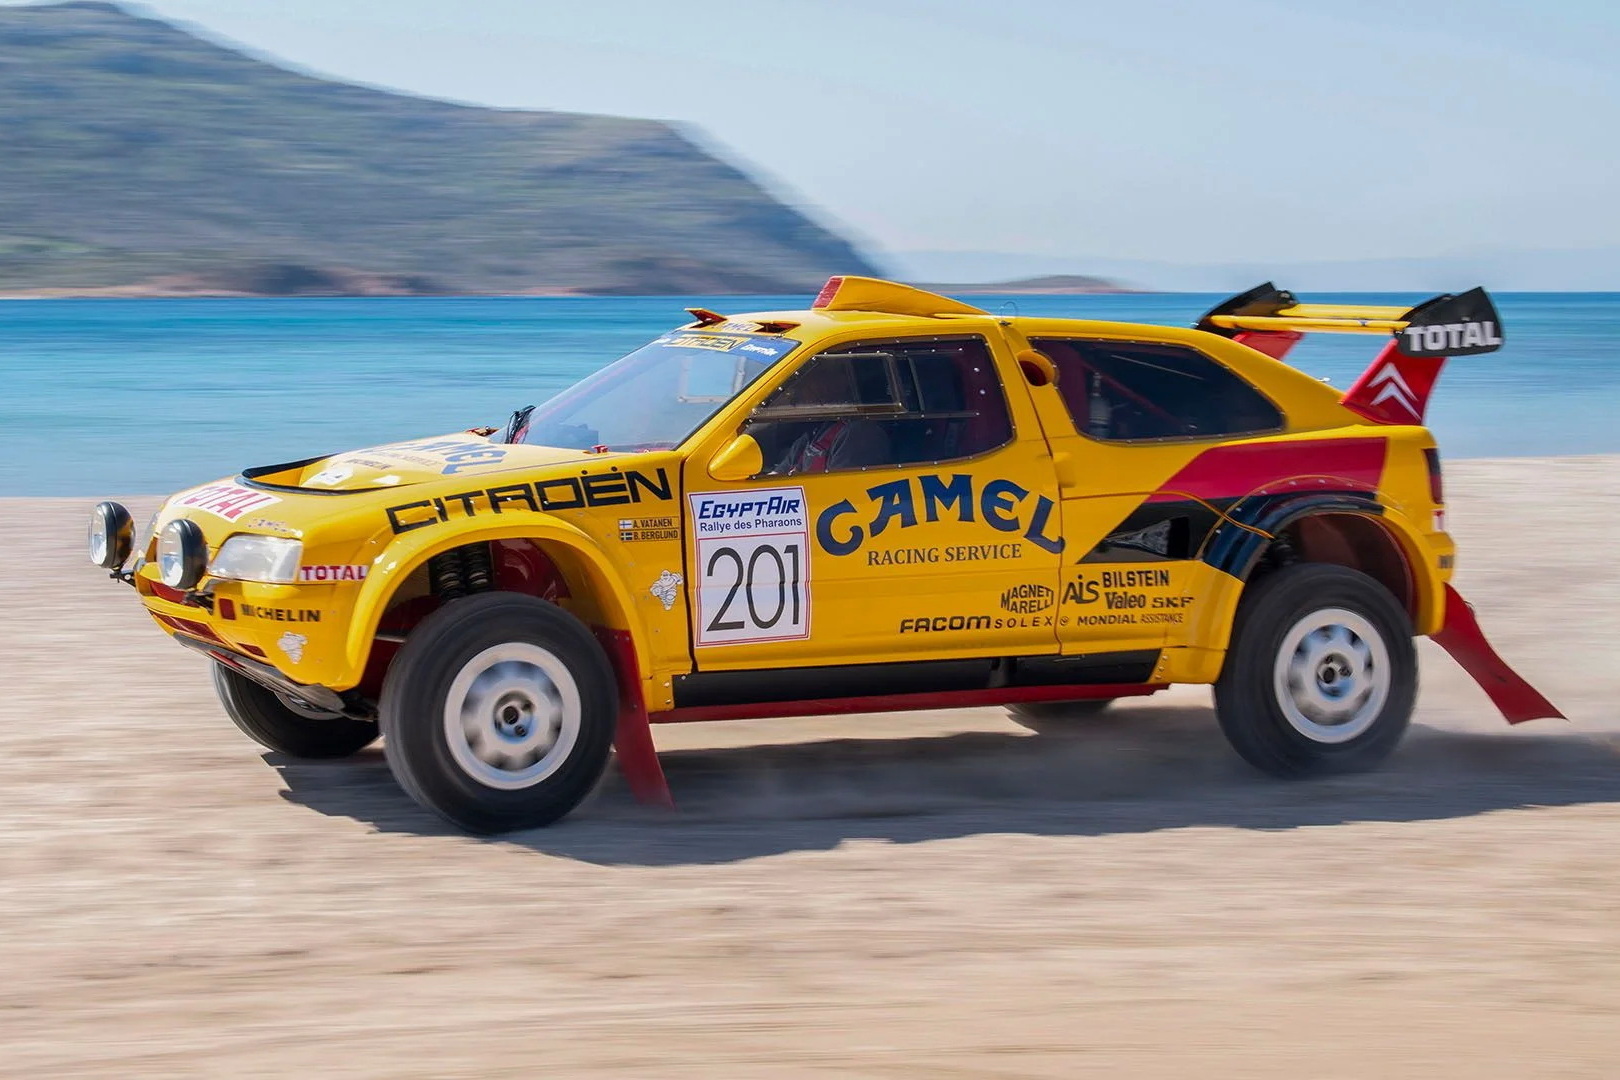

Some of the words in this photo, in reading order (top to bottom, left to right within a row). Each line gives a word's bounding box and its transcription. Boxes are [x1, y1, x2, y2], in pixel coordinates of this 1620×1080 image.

[1405, 321, 1501, 351] TOTAL
[173, 486, 272, 519] TOTAL
[816, 473, 1065, 556] CAMEL
[633, 520, 640, 528] A.
[641, 519, 673, 528] VATANEN
[700, 522, 731, 533] Rallye
[734, 520, 752, 530] des
[754, 518, 802, 528] Pharaons
[634, 532, 640, 540] B.
[641, 530, 678, 540] BERGLUND
[867, 548, 939, 566] RACING
[945, 543, 1022, 561] SERVICE
[302, 566, 366, 580] TOTAL
[1103, 570, 1169, 588] BILSTEIN
[707, 544, 799, 631] 201
[1105, 592, 1146, 609] Valeo
[1152, 597, 1194, 609] SKF
[241, 604, 321, 622] MICHELIN
[1077, 614, 1137, 626] MONDIAL
[994, 616, 1053, 629] SOLEX
